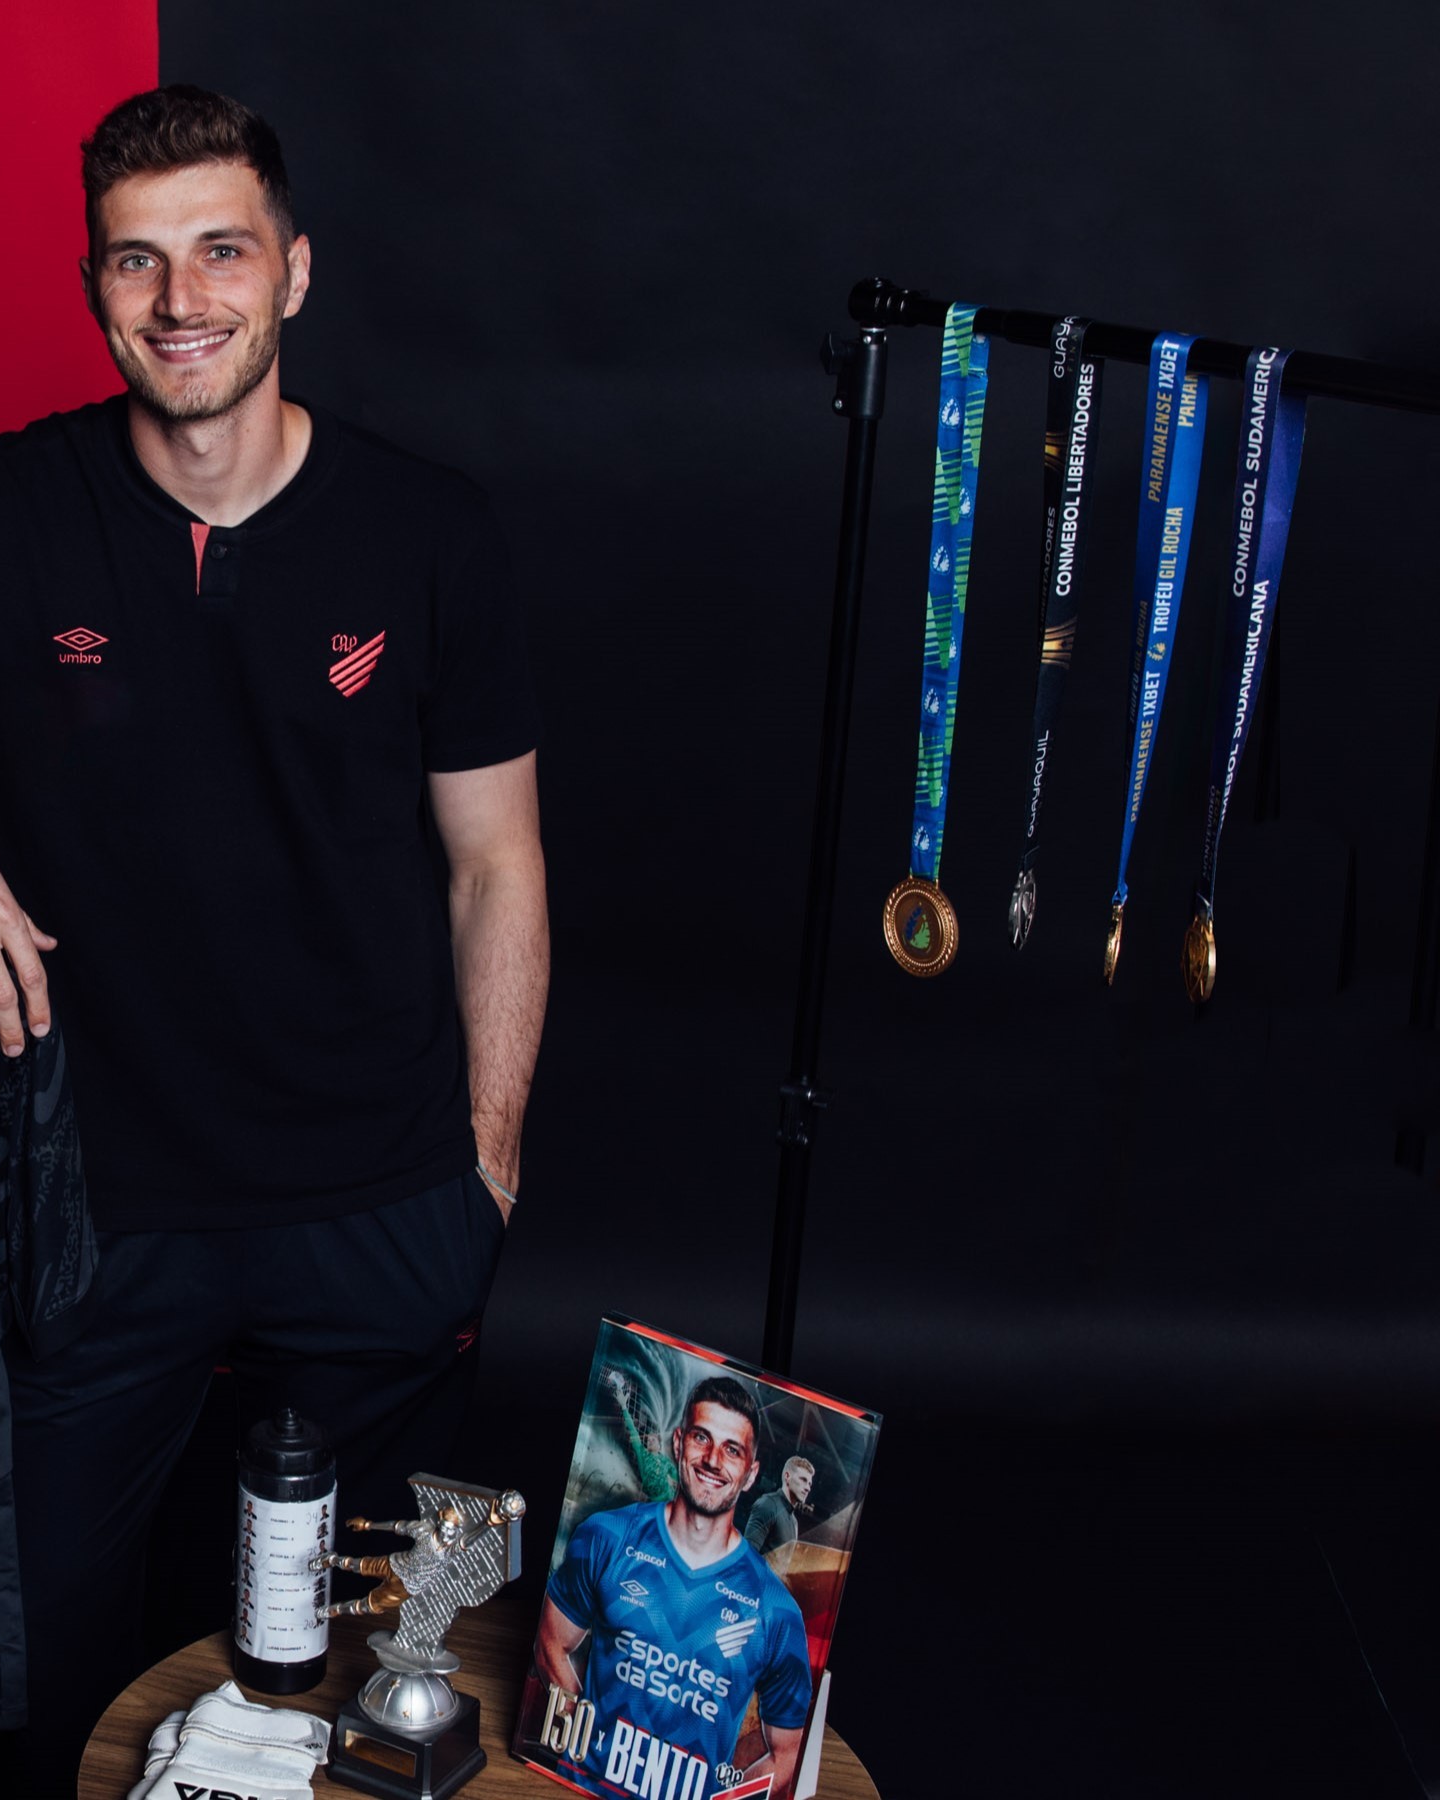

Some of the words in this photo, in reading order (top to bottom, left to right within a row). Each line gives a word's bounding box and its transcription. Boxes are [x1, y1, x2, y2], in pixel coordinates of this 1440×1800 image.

[1158, 339, 1180, 389] 1XBET
[1066, 363, 1095, 492] LIBERTADORES
[1148, 391, 1172, 503] PARANAENSE
[1055, 496, 1080, 597] CONMEBOL
[1162, 507, 1184, 554] ROCHA
[1232, 478, 1258, 598] CONMEBOL
[1159, 556, 1177, 579] GIL
[1153, 582, 1174, 634] TROFÉU
[58, 652, 102, 664] umbro
[1233, 579, 1270, 738] SUDAMERICANA
[1130, 719, 1154, 823] PARANAENSE
[1142, 671, 1160, 717] 1XBET
[1027, 729, 1049, 838] GUAYAQUIL
[619, 1594, 646, 1607] umbro
[714, 1581, 760, 1609] Copacol
[615, 1630, 732, 1698] Esportes
[615, 1660, 647, 1690] da
[647, 1670, 719, 1724] Sorte
[540, 1683, 596, 1763] 150
[604, 1717, 709, 1800] BENTO
